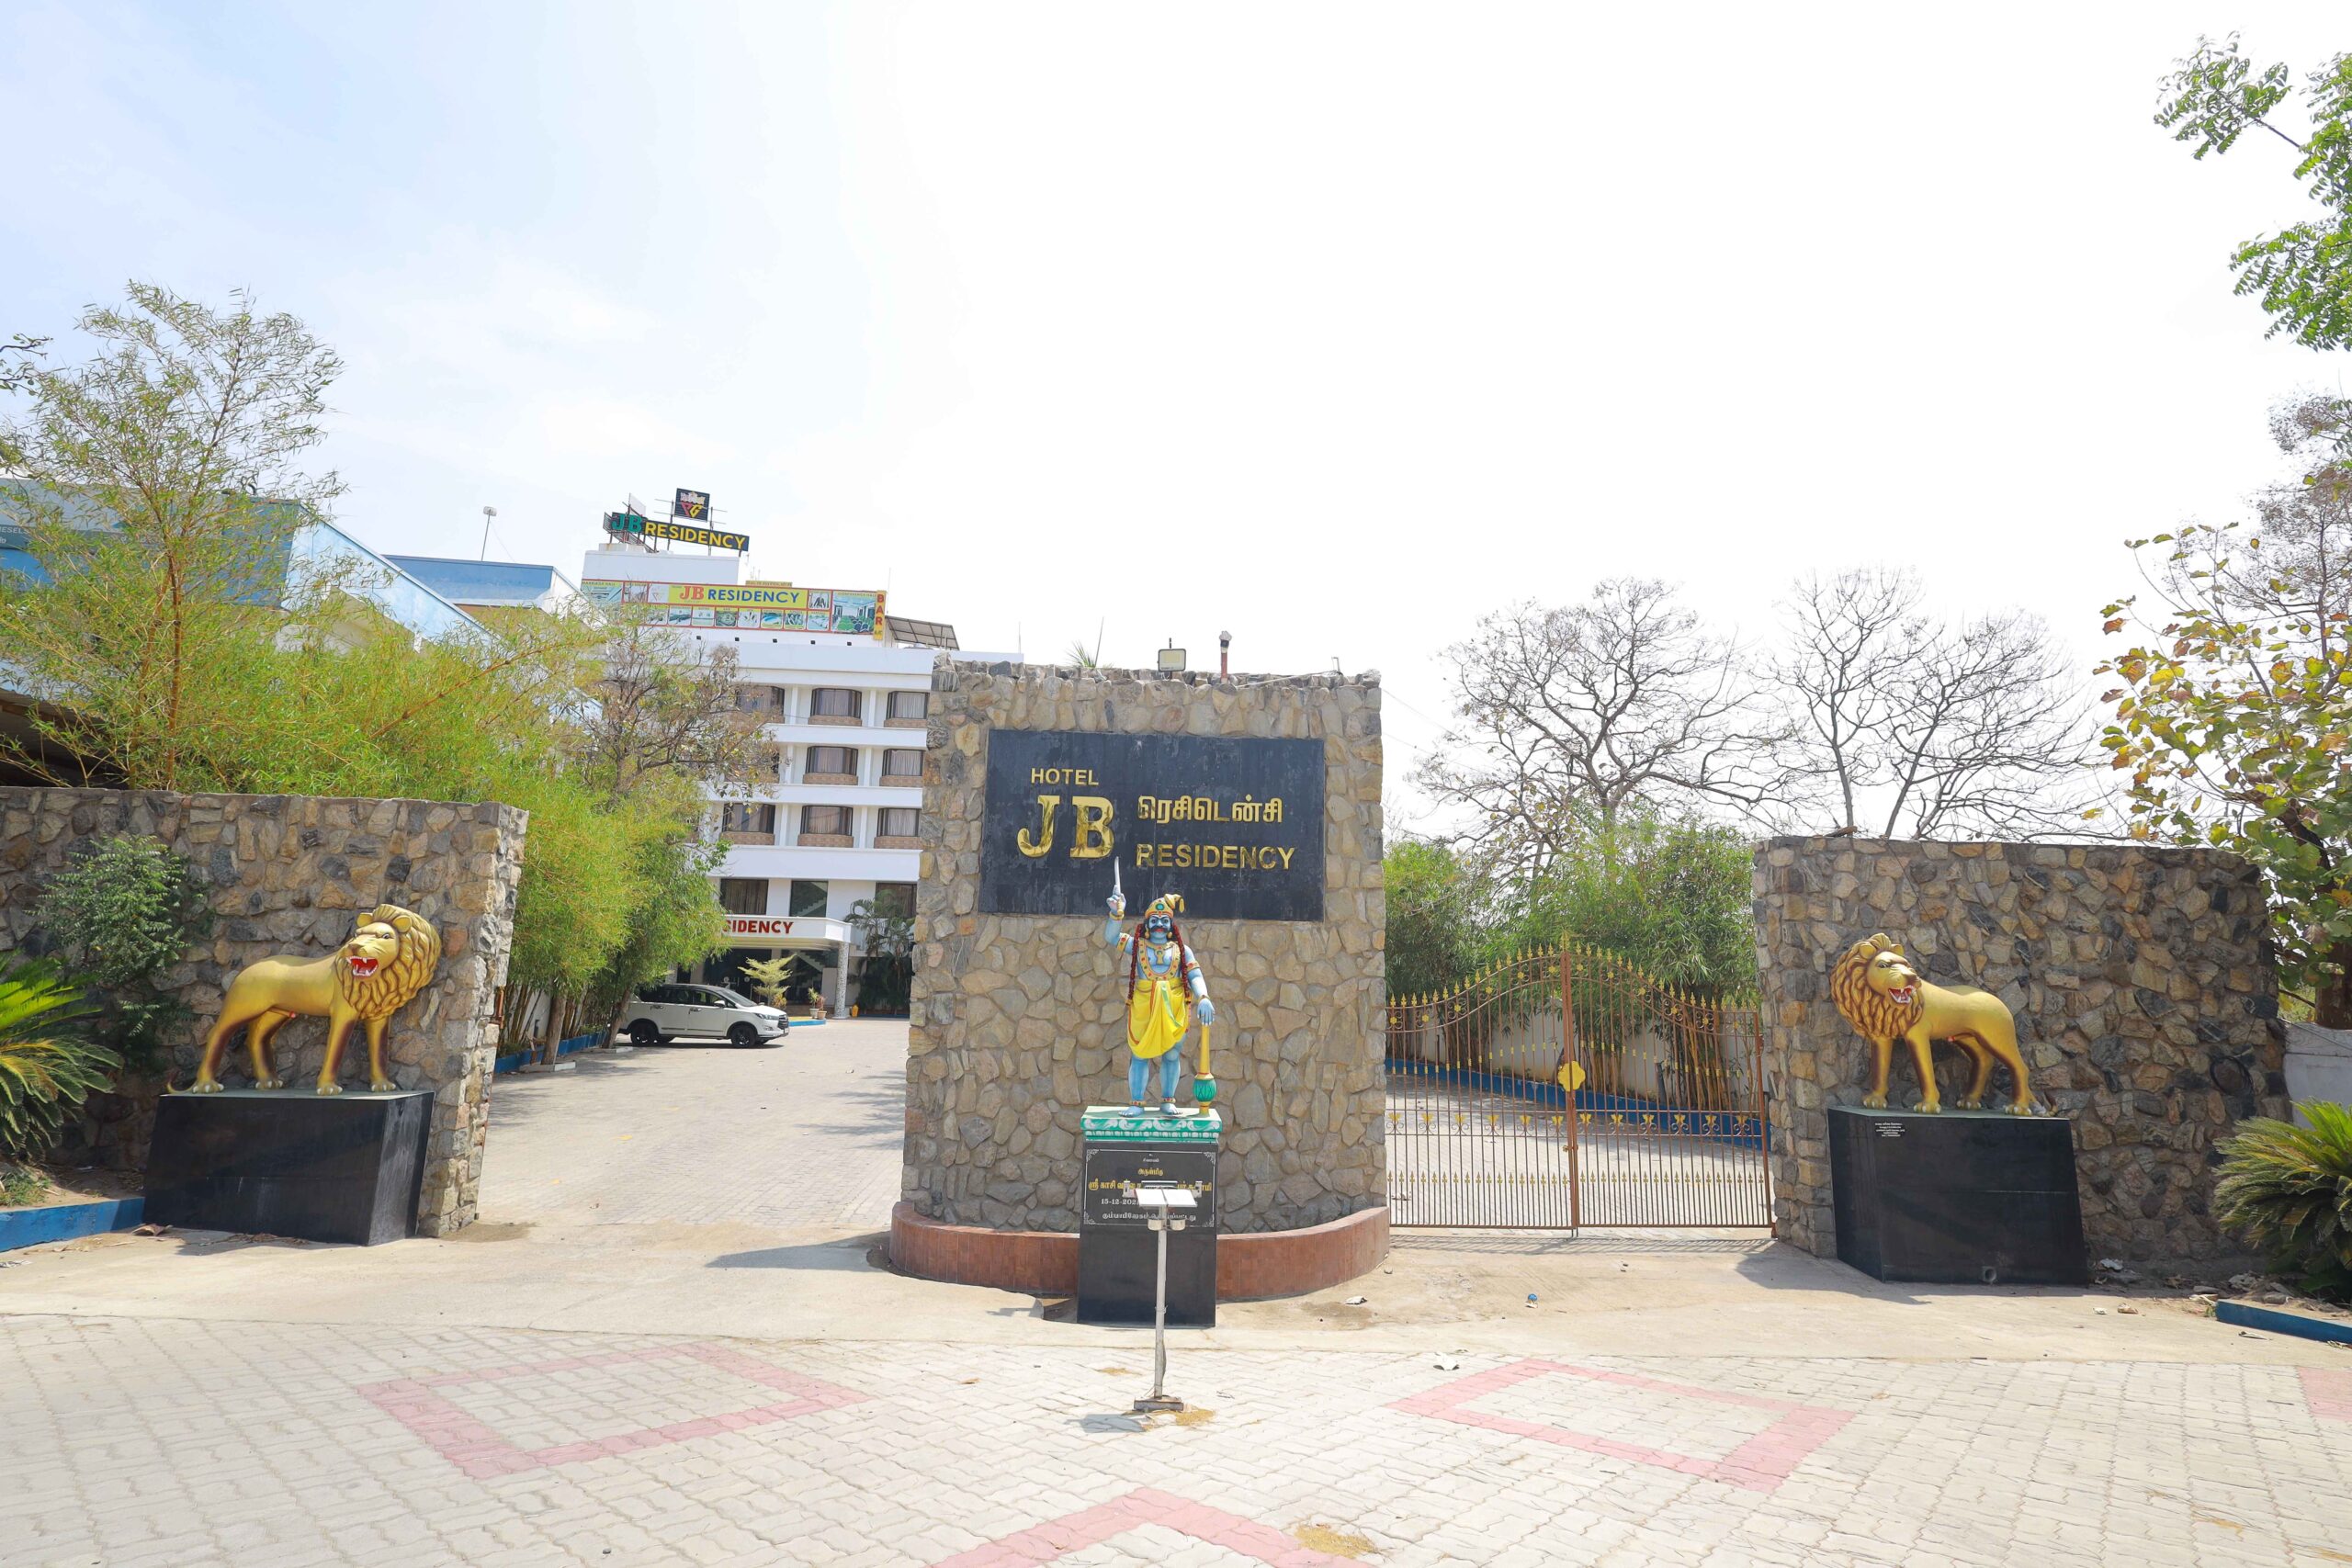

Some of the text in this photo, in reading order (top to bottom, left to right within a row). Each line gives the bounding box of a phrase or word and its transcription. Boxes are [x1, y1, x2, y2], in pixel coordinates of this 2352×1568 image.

[611, 513, 746, 549] JB RESIDENCY
[680, 585, 800, 604] JB RESIDENCY
[875, 593, 885, 626] BAR
[1031, 768, 1100, 786] HOTEL
[1137, 794, 1283, 824] ரெசிடென்சி
[1016, 795, 1115, 859] JB
[1136, 843, 1295, 870] RESIDENCY
